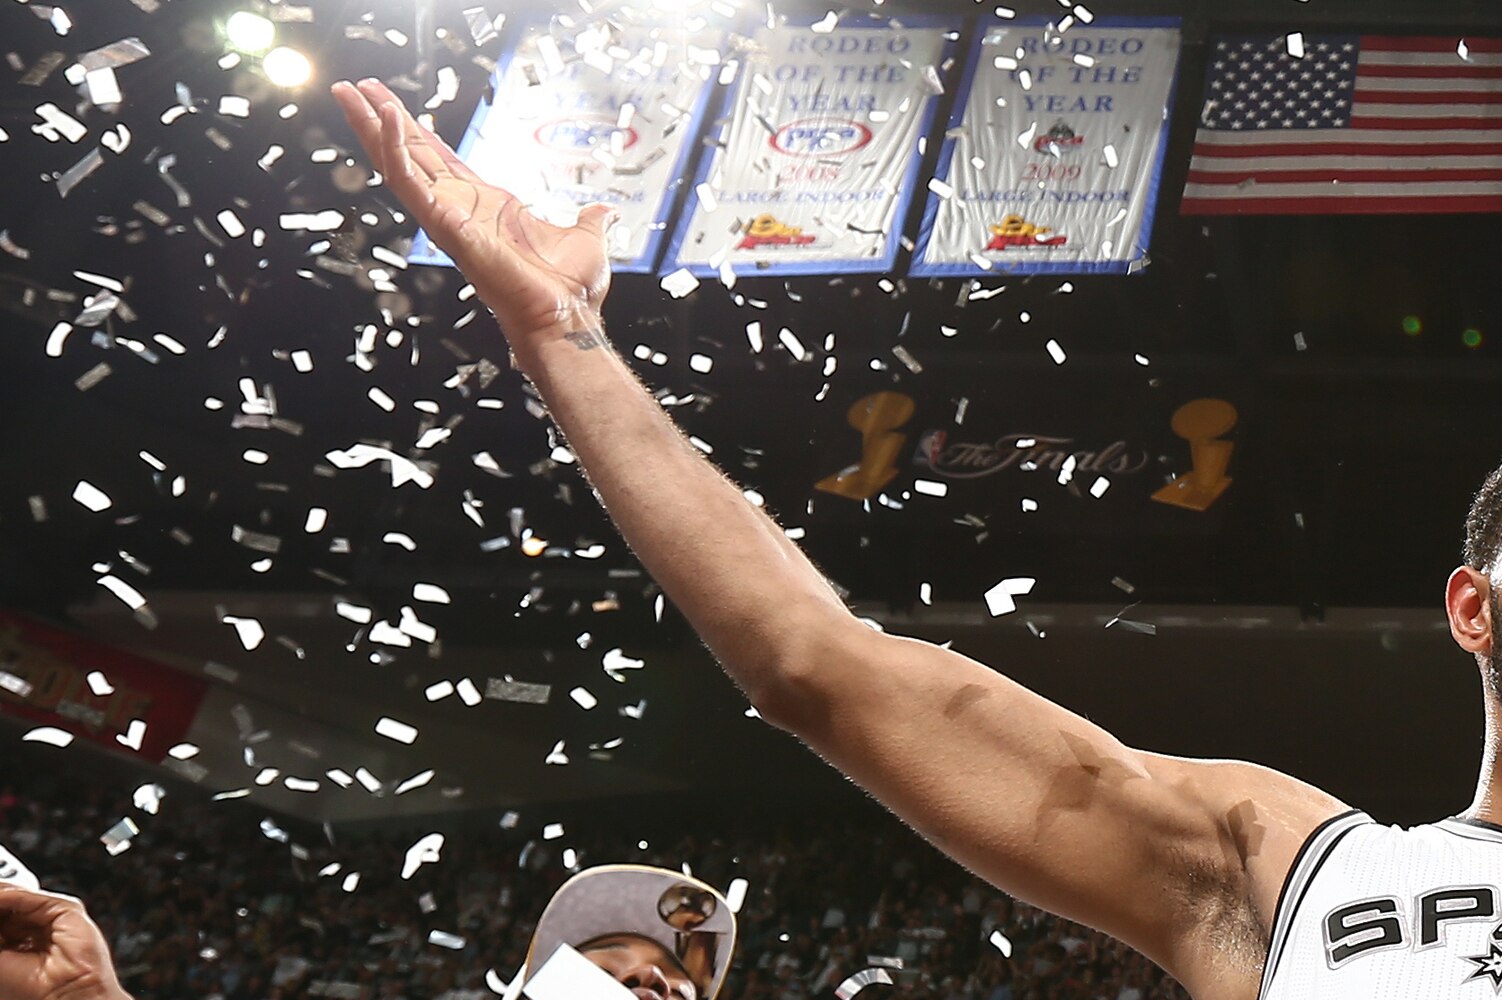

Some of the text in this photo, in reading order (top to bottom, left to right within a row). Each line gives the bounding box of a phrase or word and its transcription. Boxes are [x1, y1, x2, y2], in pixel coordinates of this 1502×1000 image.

[788, 36, 912, 54] RODEO
[773, 63, 905, 83] OF THE
[1069, 67, 1144, 83] THE
[788, 94, 877, 112] YEAR
[1024, 95, 1115, 113] YEAR
[1021, 164, 1082, 181] 2009
[794, 189, 885, 203] INDOOR
[962, 189, 1130, 203] LARGE INDOOR
